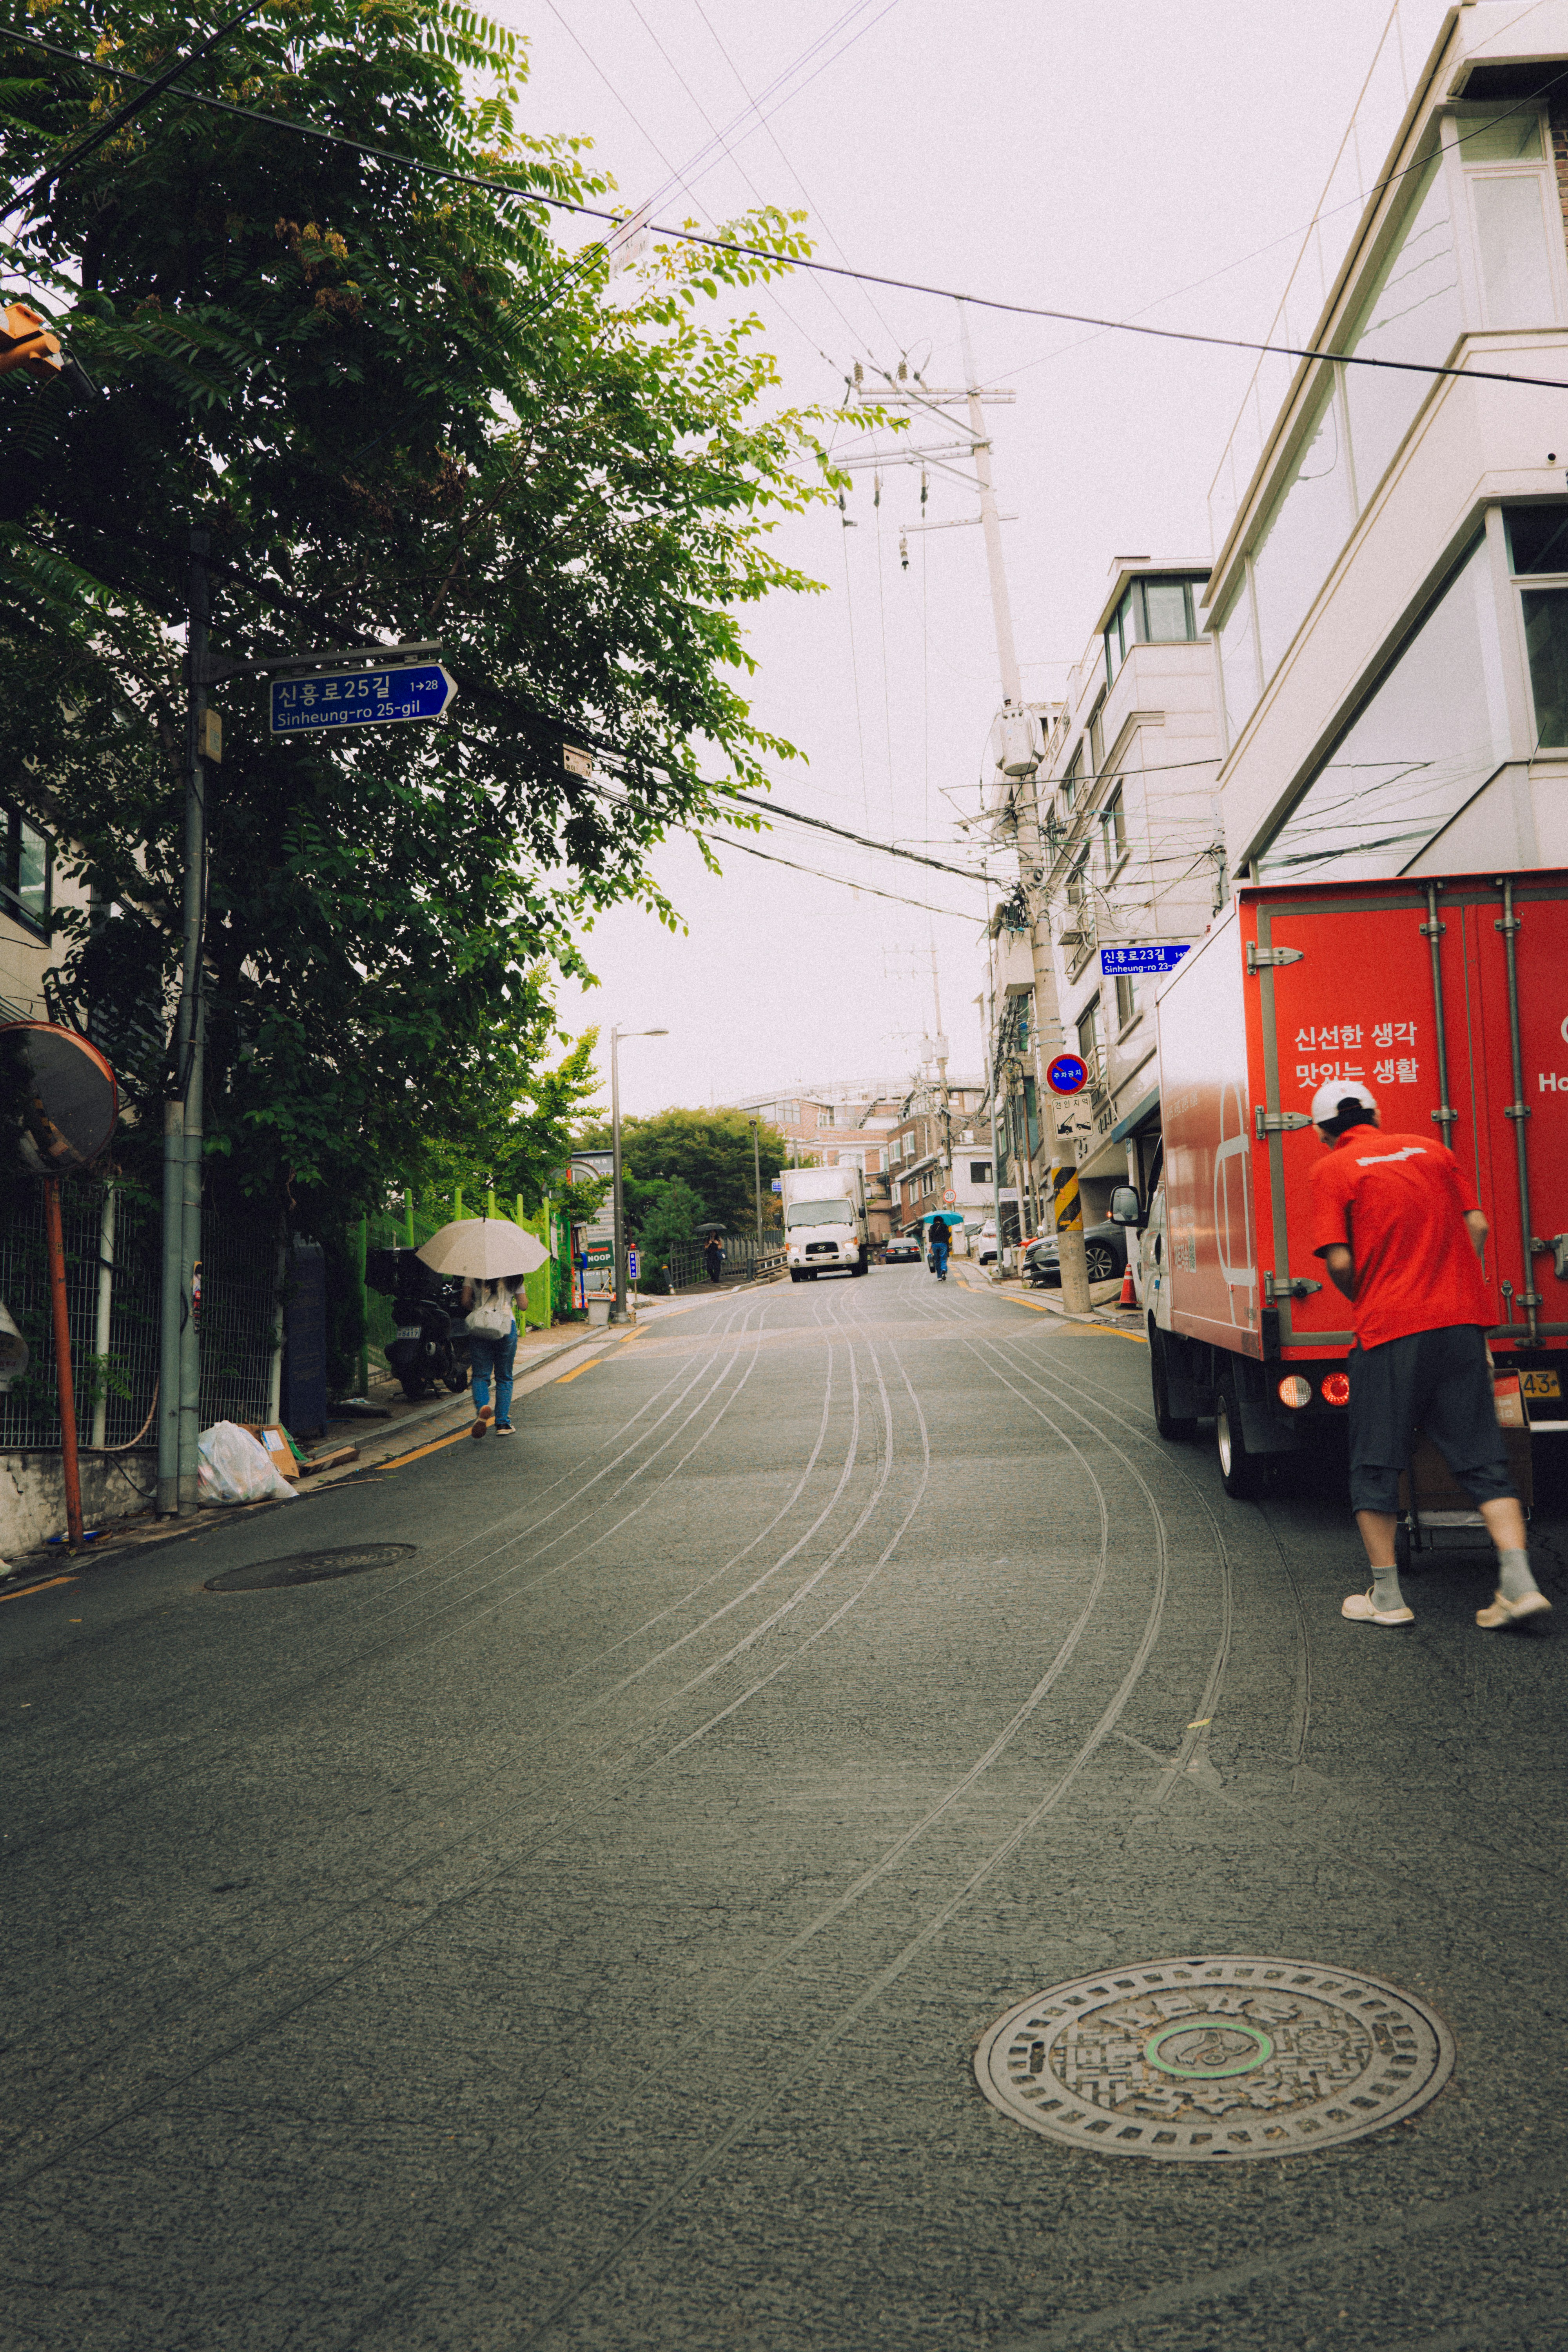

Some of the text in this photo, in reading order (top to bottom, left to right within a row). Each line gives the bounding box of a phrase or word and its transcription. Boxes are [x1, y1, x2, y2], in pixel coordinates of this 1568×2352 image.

[278, 675, 390, 708] 신흥로25길
[278, 700, 420, 726] Sinheung-ro 25-gil
[1104, 948, 1165, 964] 신흥로23길
[1105, 965, 1156, 973] Sinheung-ro
[1295, 1022, 1417, 1051] 신선한 생각
[1054, 1069, 1081, 1079] 주차금지
[1296, 1058, 1419, 1088] 맛있는 생활
[1055, 1098, 1088, 1109] 견인지역
[588, 1254, 611, 1262] NOOP
